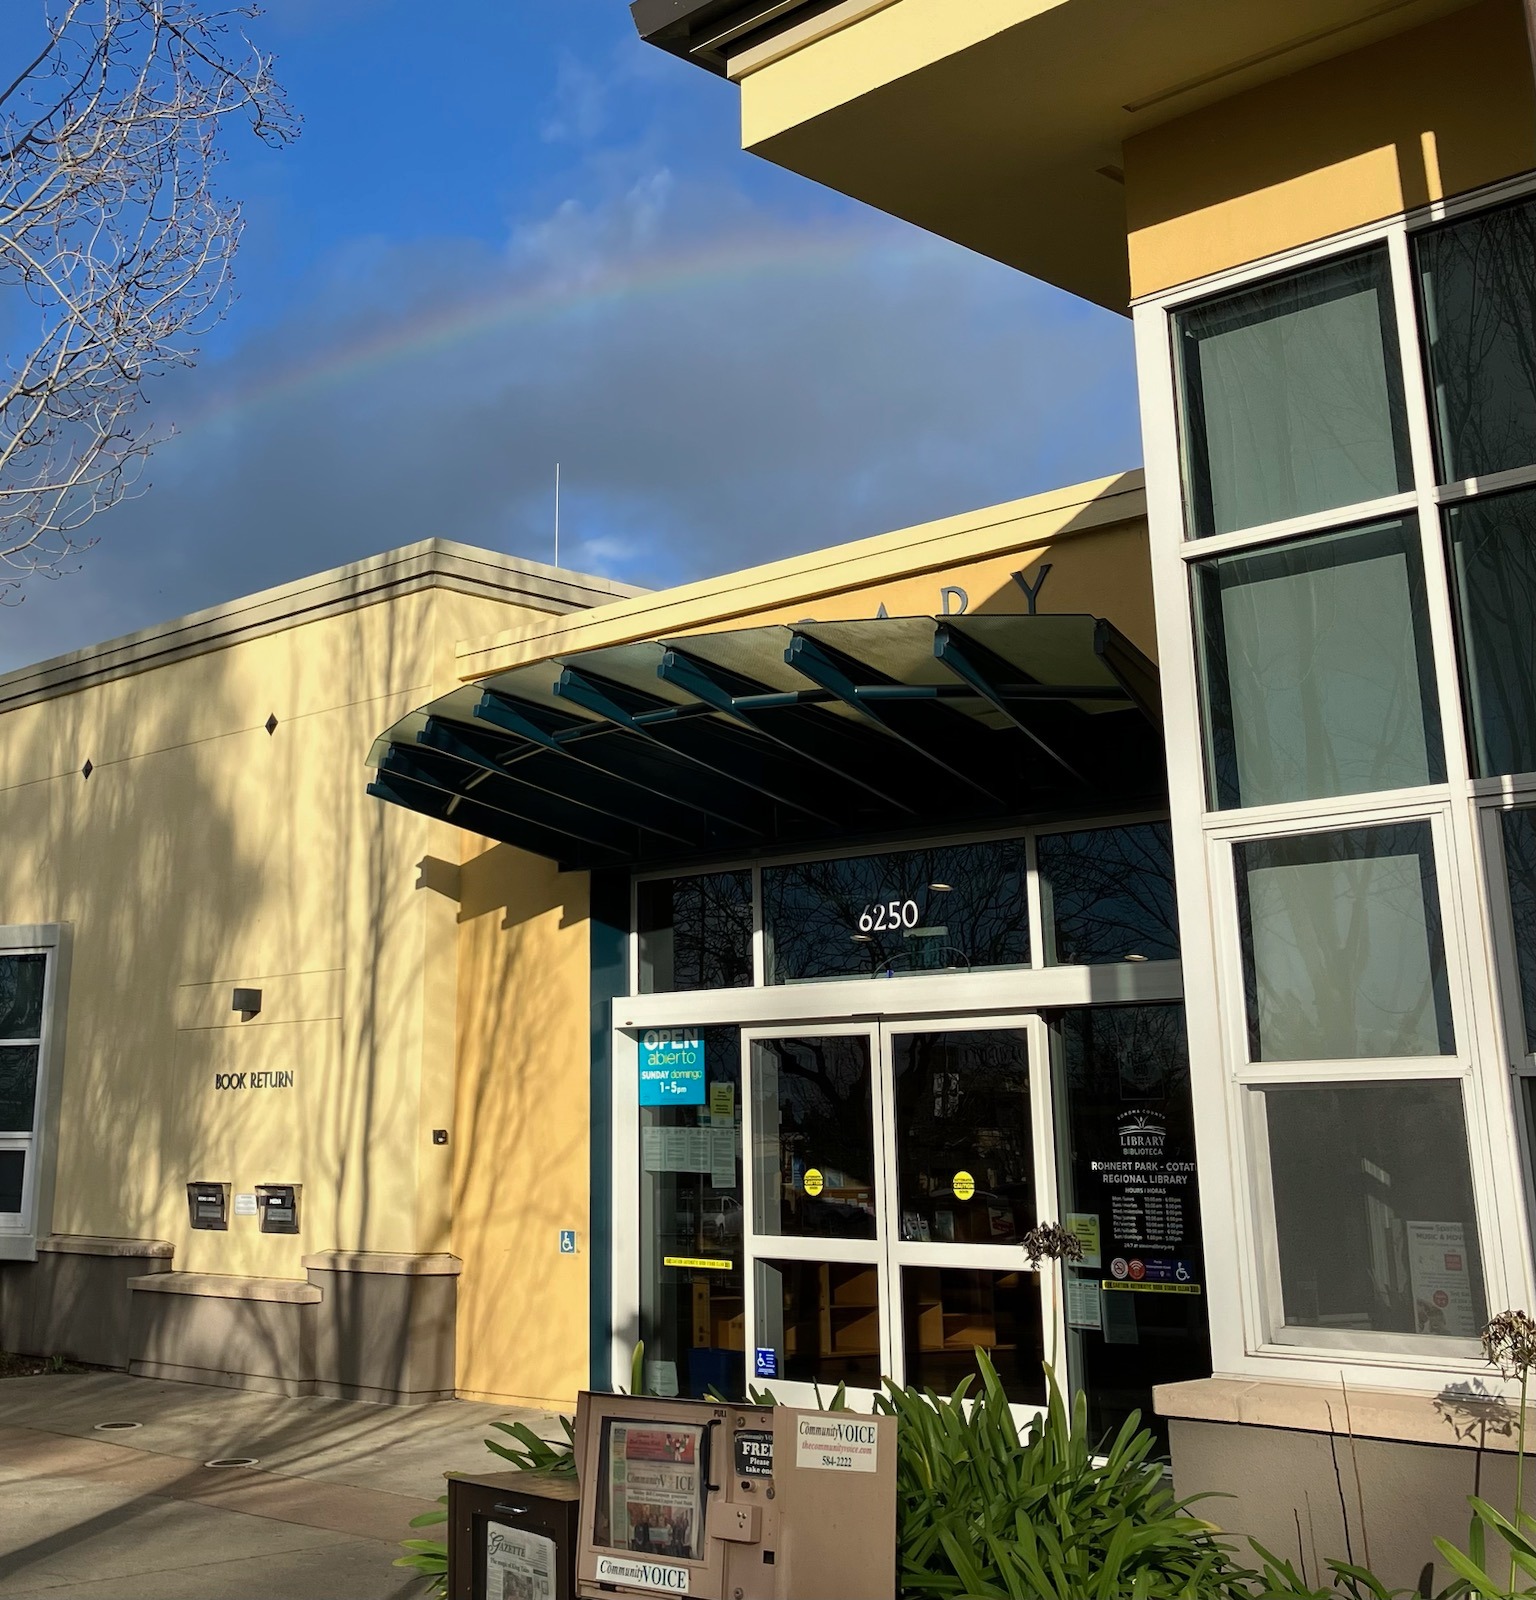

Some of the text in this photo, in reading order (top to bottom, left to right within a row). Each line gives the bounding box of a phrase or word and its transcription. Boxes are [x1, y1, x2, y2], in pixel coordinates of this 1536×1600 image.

[859, 900, 918, 932] 6250
[643, 1029, 698, 1051] OPEN
[648, 1050, 696, 1065] aberto
[215, 1070, 294, 1090] BOOK RETURN
[641, 1070, 702, 1080] SUNDAY domingo
[1120, 1136, 1165, 1146] LIBRARY
[1123, 1148, 1163, 1156] BIBLIOTECA
[1091, 1161, 1133, 1171] ROHNERT
[1134, 1162, 1158, 1171] PARK
[1103, 1174, 1187, 1185] REGIONAL LIBRARY
[802, 1441, 872, 1455] thecommunityvoice.com
[750, 1457, 769, 1466] Please
[822, 1455, 852, 1467] 584-2222
